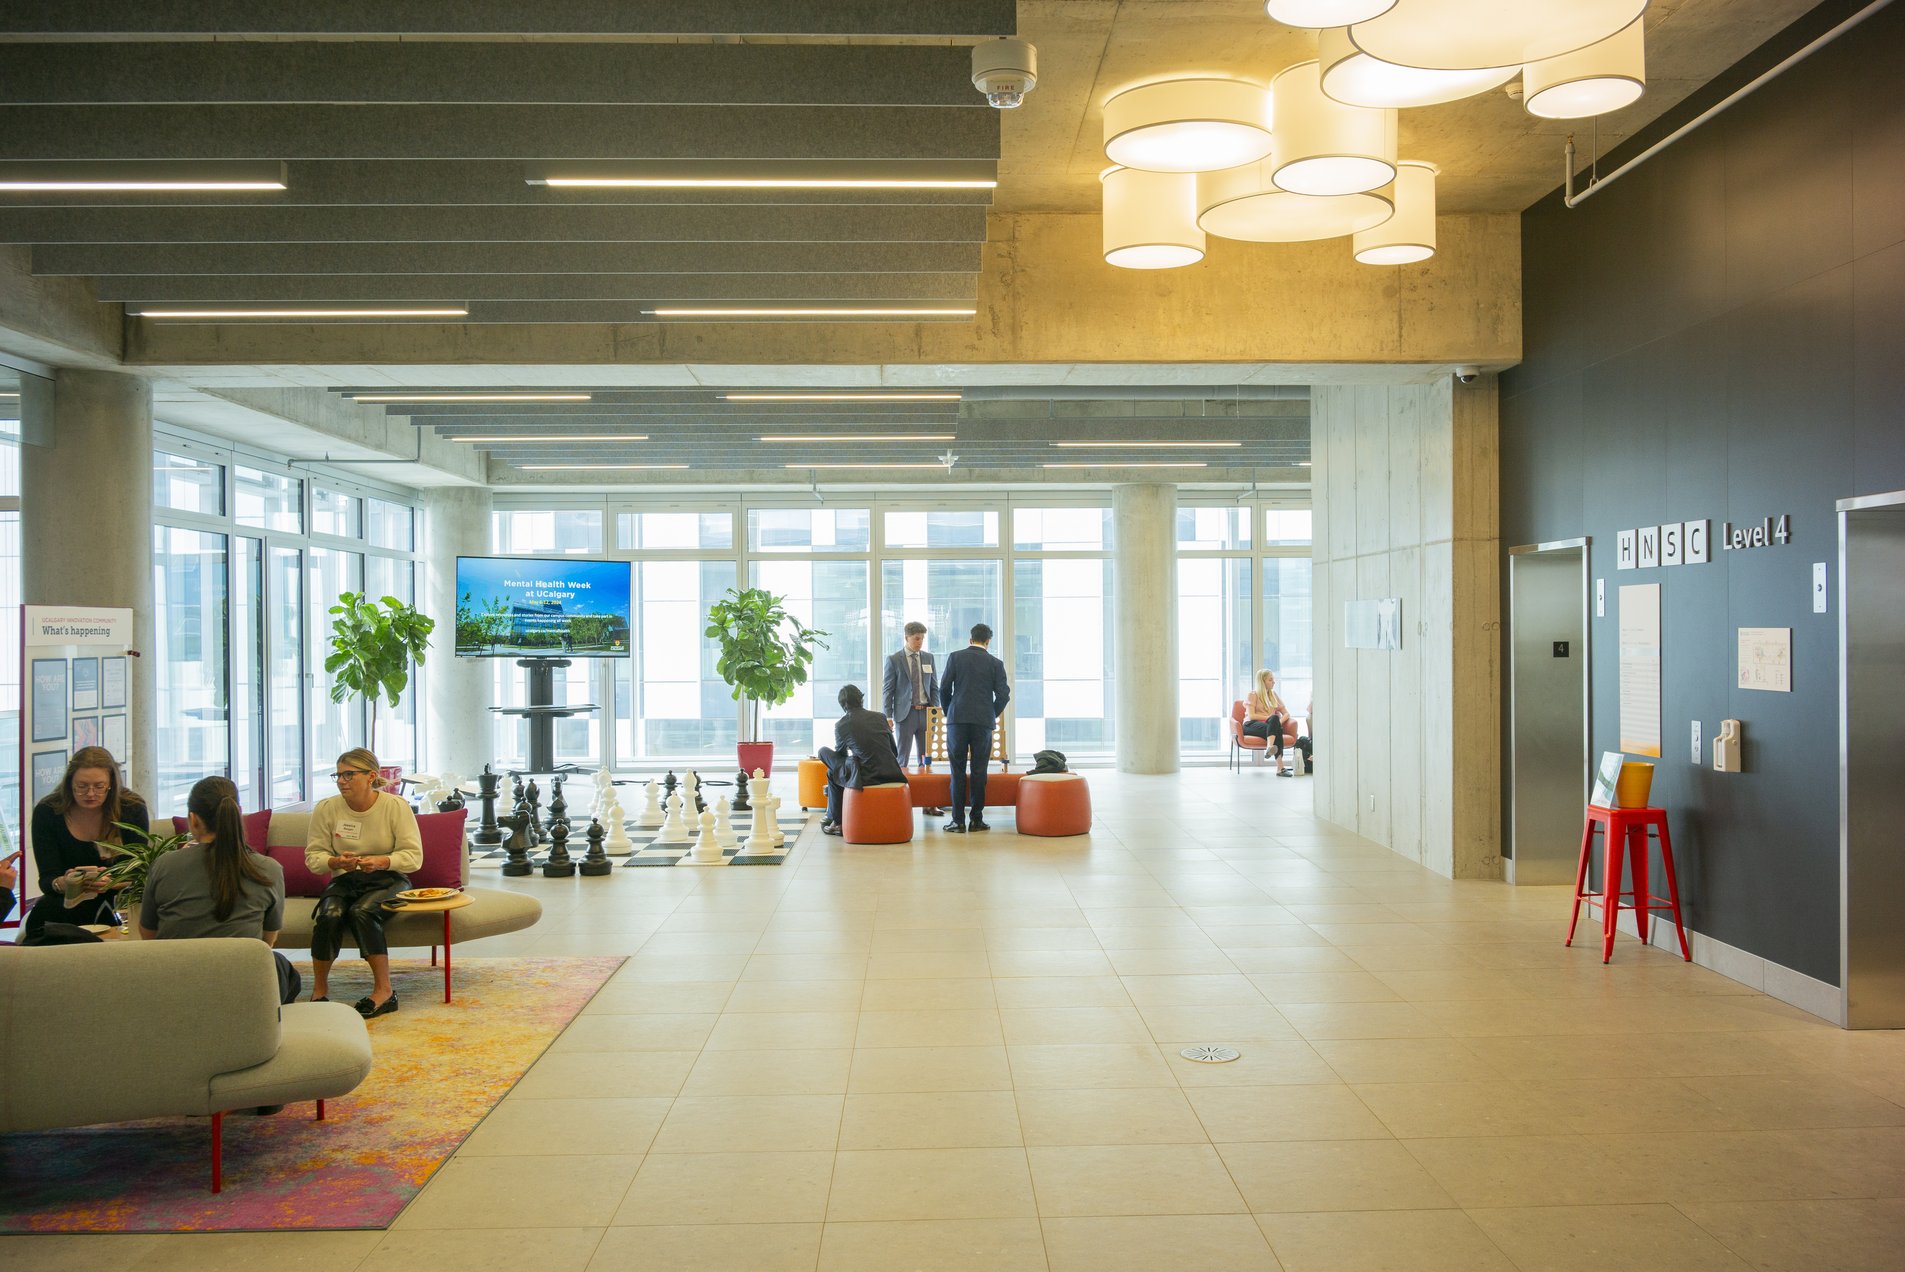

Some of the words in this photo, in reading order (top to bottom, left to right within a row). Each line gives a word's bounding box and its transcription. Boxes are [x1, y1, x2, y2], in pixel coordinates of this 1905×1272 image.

[1620, 526, 1701, 562] HNSC
[1723, 517, 1769, 550] Level
[1774, 514, 1789, 545] 4
[536, 580, 564, 588] Health
[568, 581, 591, 589] Week
[536, 590, 575, 599] UCalgary
[42, 626, 68, 635] What's
[70, 626, 110, 637] happening
[1558, 644, 1564, 653] 4
